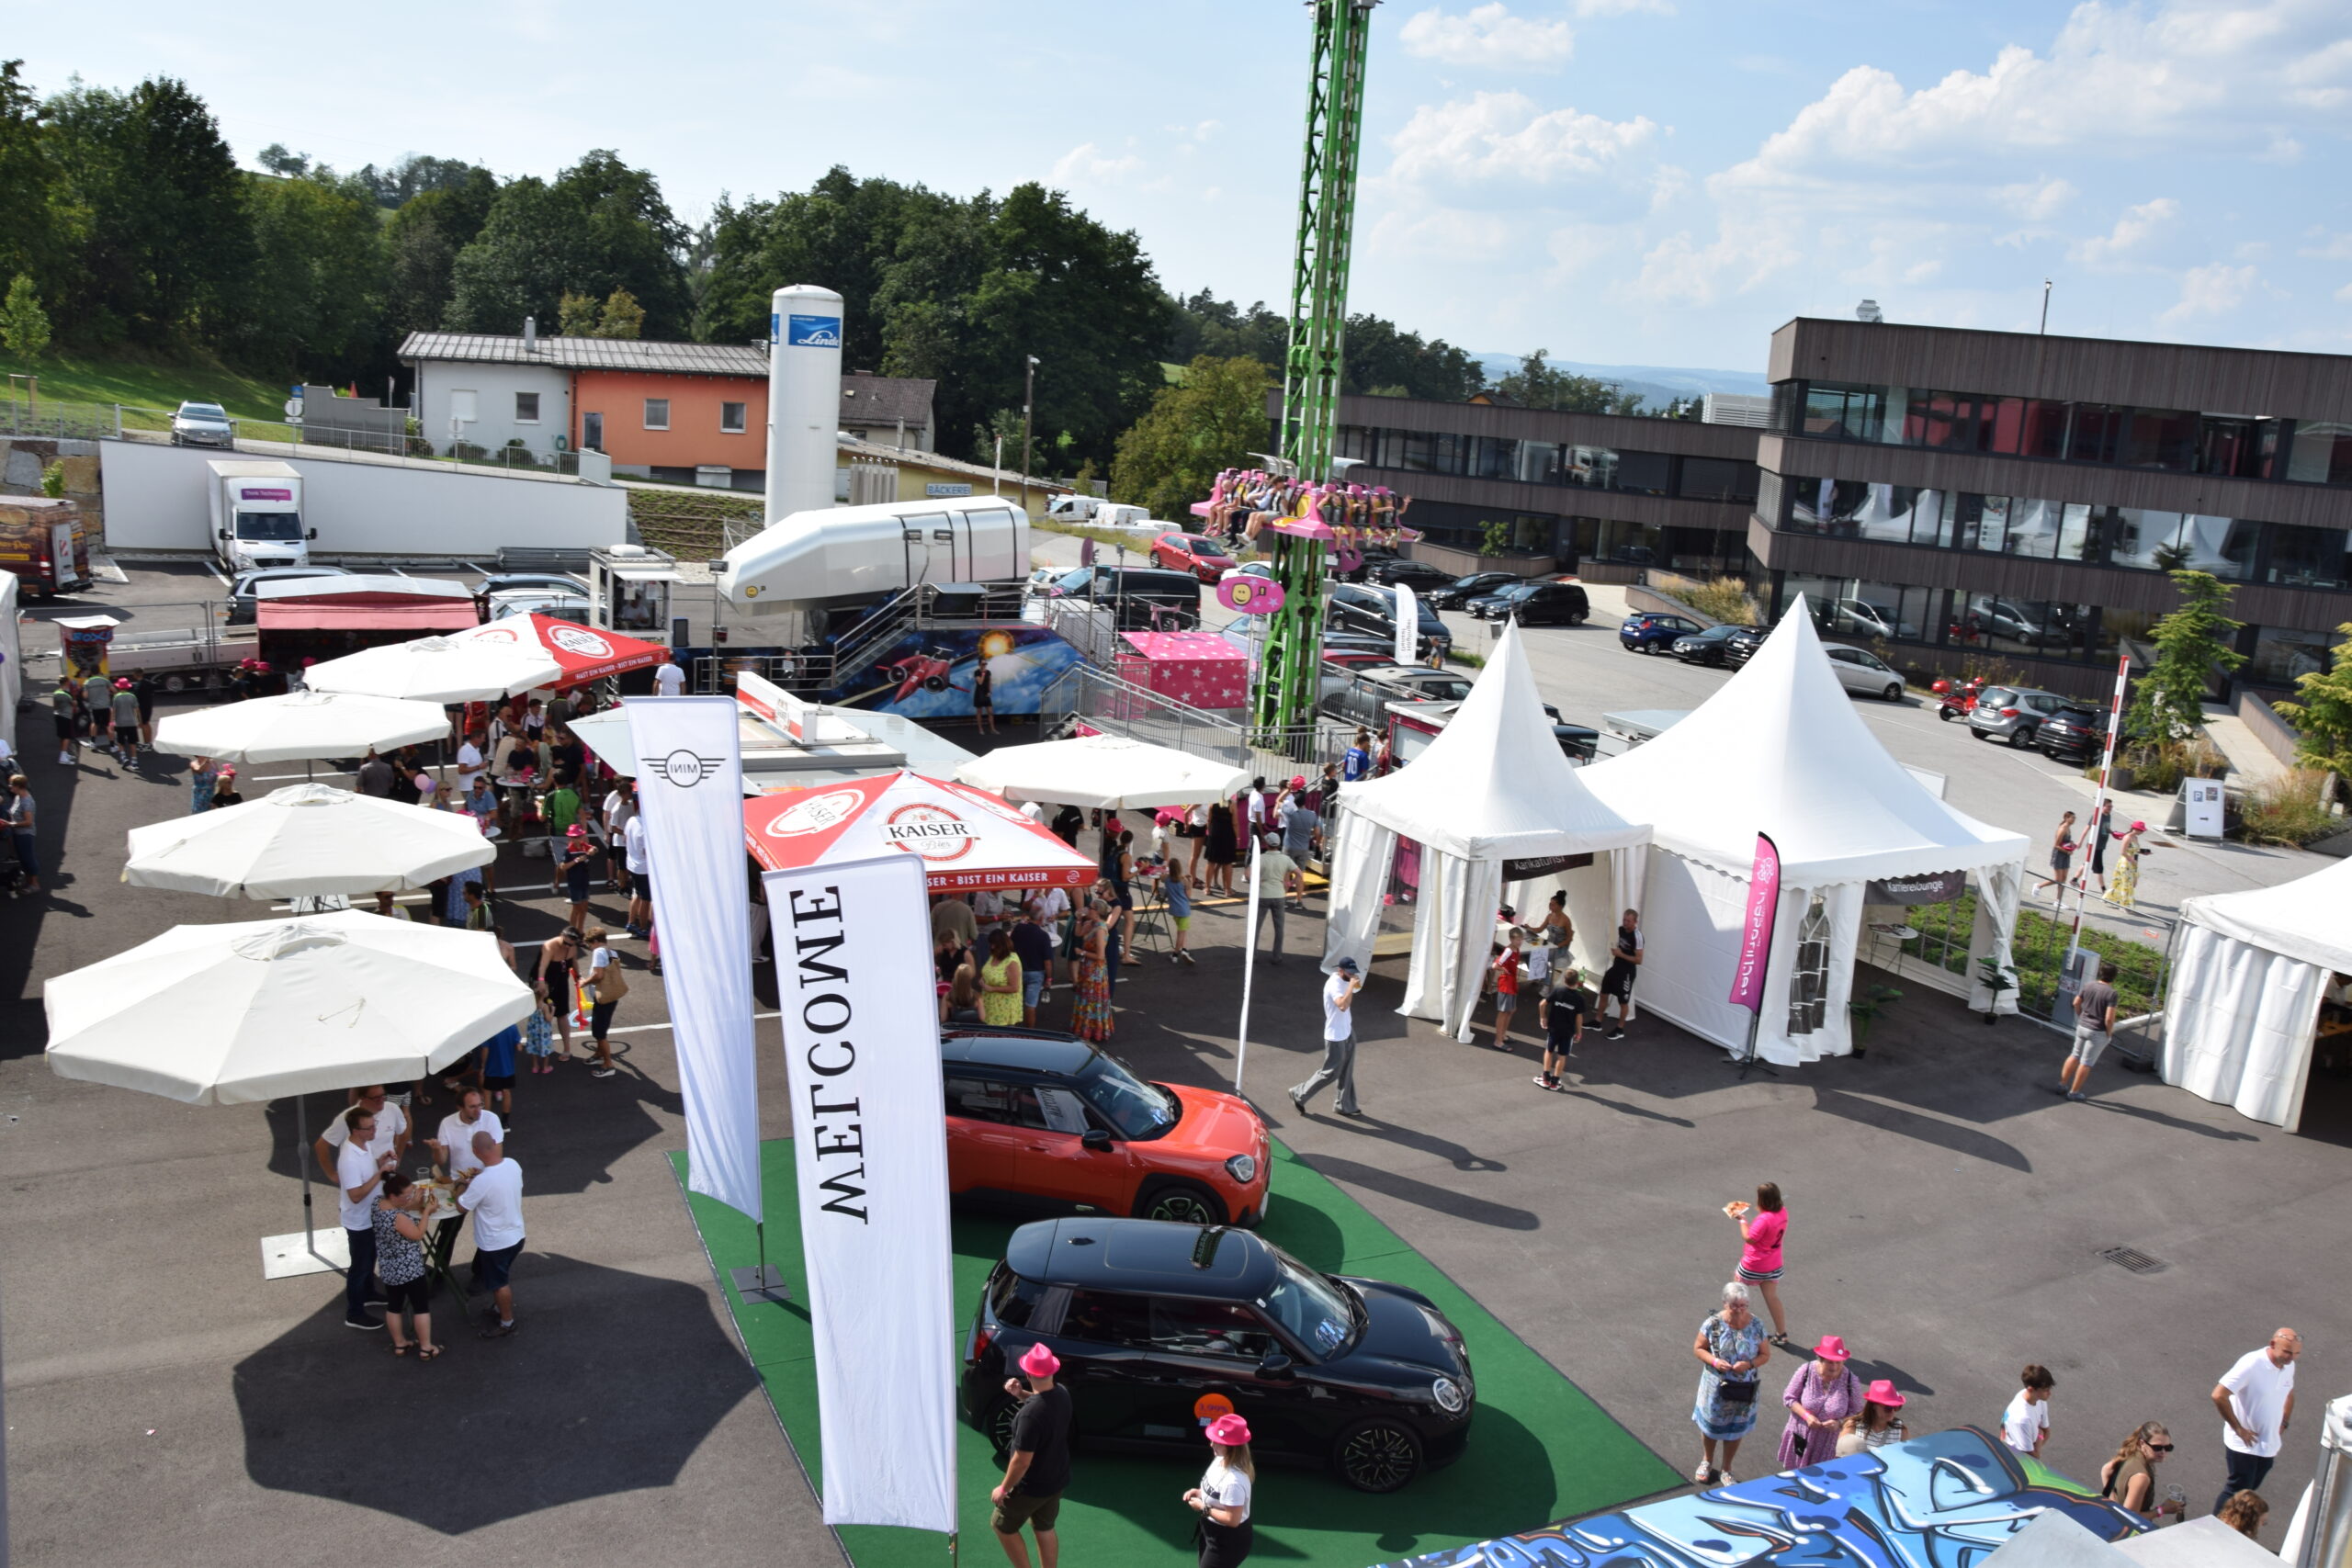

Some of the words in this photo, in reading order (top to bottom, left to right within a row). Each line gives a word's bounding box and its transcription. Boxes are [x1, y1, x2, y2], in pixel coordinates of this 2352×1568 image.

[928, 484, 971, 495] BÄCKEREI
[560, 635, 599, 649] KAISER
[1347, 756, 1358, 775] 10
[888, 823, 969, 839] KAISER
[920, 840, 951, 851] Bier
[927, 876, 947, 887] SER
[956, 874, 982, 886] BIST
[985, 874, 1005, 884] EIN
[1009, 873, 1048, 883] KAISER
[1770, 1229, 1784, 1249] 2
